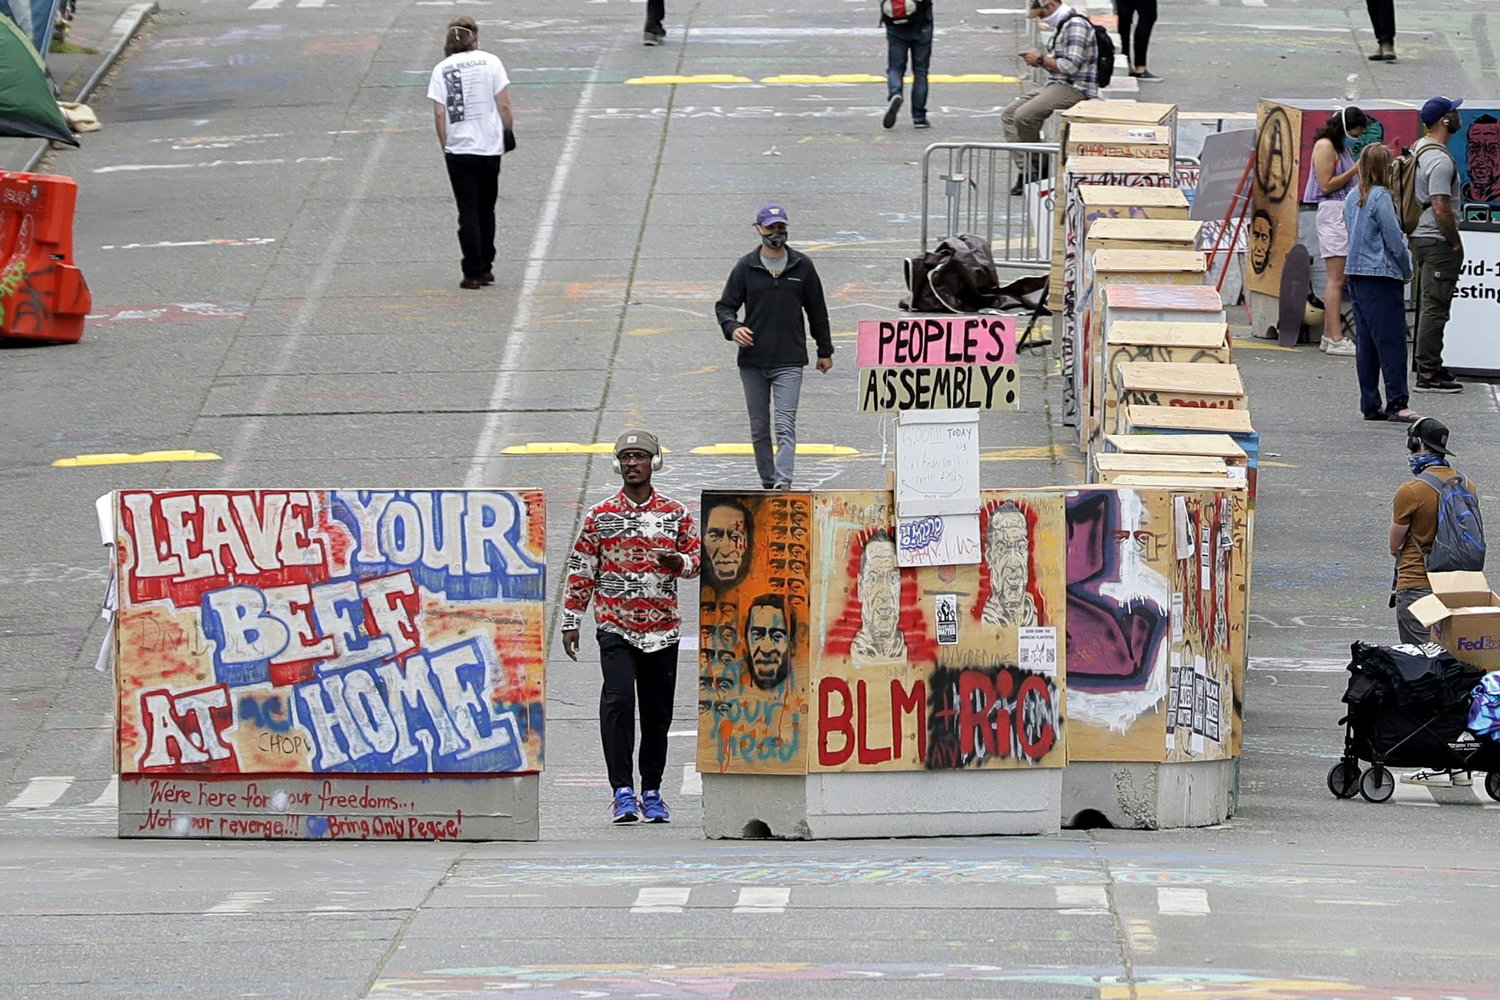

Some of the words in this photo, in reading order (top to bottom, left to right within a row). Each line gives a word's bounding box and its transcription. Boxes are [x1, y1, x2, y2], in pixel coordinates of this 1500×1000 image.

[878, 318, 1006, 366] PEOPLE'S
[863, 366, 1016, 412] ASSEMBLY:
[947, 428, 972, 440] TODAY
[123, 490, 328, 584] LEAVE
[331, 490, 541, 578] YOUR
[207, 580, 421, 670] BEEF
[1457, 636, 1500, 650] FedEx
[143, 687, 234, 769] AT
[301, 649, 516, 771] HOME
[818, 677, 926, 766] BLM
[139, 809, 173, 831] Not
[328, 815, 369, 839] Bring
[372, 815, 405, 839] Only
[408, 809, 463, 839] Peace!
[149, 781, 191, 804] We're
[198, 783, 236, 807] here
[241, 783, 268, 808] for
